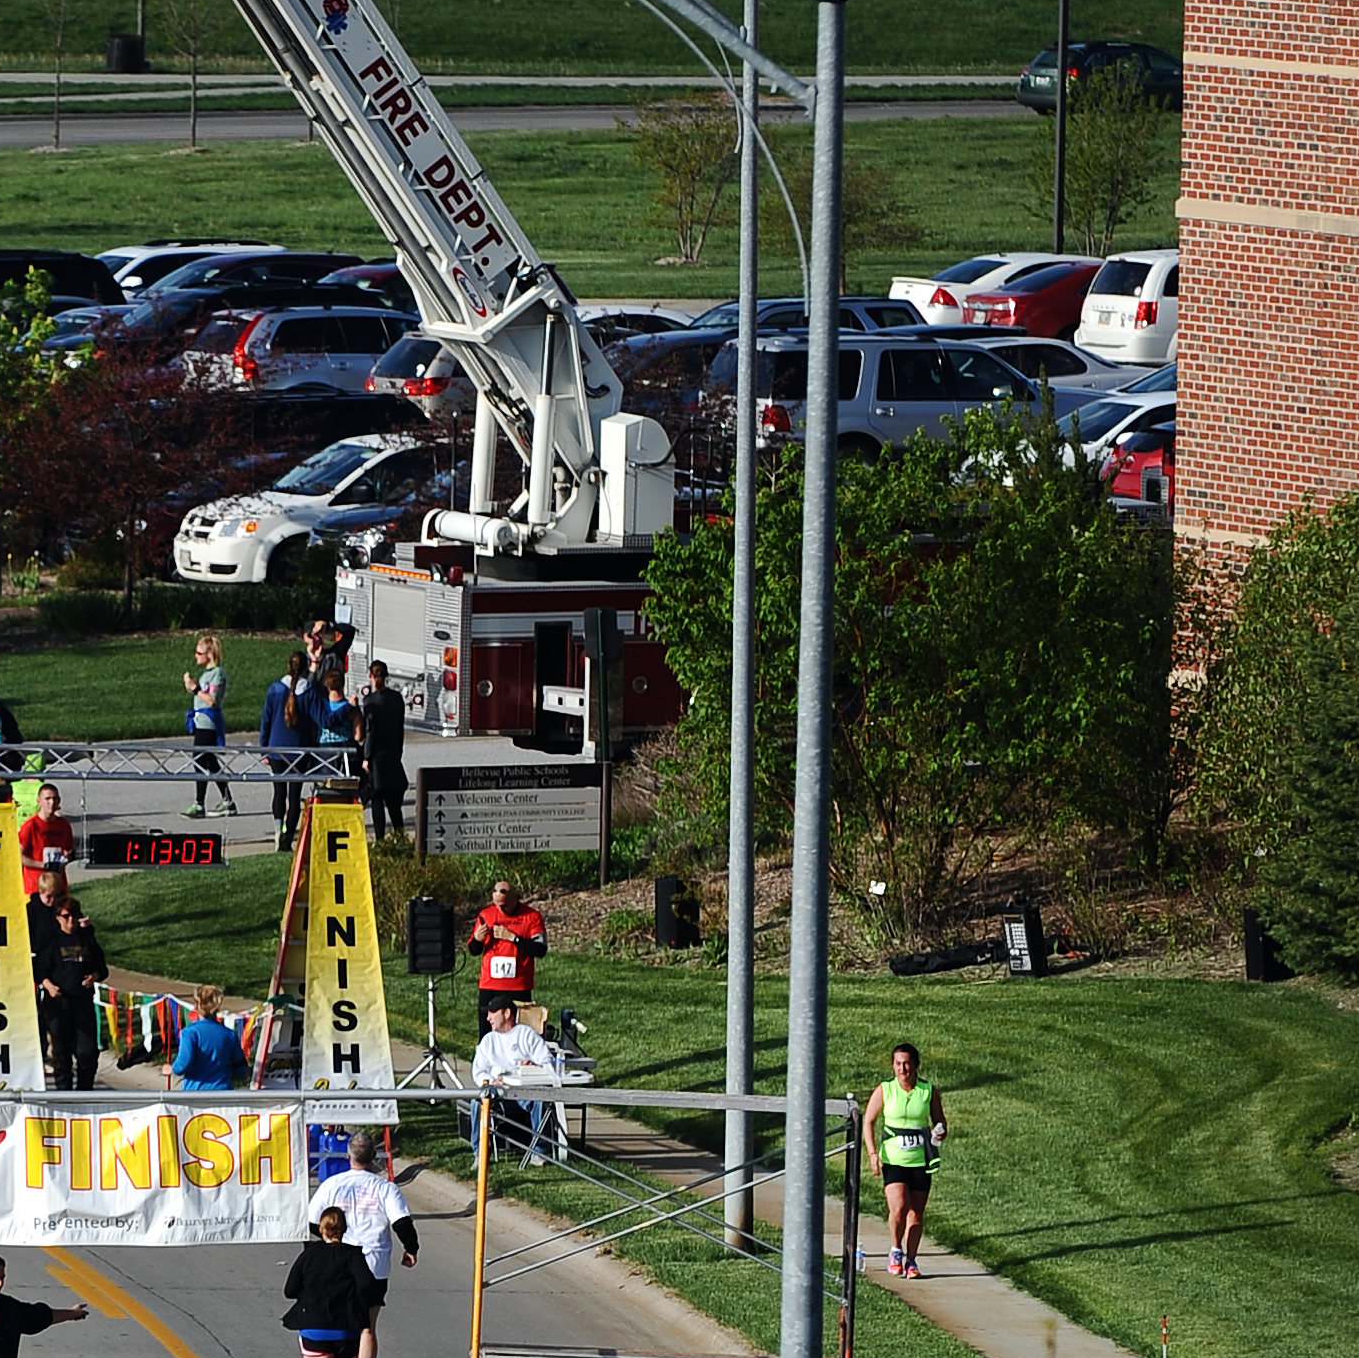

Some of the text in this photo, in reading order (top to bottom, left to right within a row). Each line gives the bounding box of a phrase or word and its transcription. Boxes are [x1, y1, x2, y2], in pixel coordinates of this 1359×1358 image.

[358, 55, 504, 267] FIRE DEPT.
[461, 765, 570, 778] Bellevue Public Schools
[458, 776, 572, 789] Lifelong Learning Center
[454, 792, 540, 805] Welcome Center
[470, 808, 585, 819] METROPOLITAN COMMUNITY COLLEGE
[454, 822, 532, 836] Activity Center
[454, 838, 552, 852] Softball Parking Lot
[326, 830, 361, 1074] FINISH
[495, 962, 513, 975] 147
[24, 1113, 292, 1192] FINISH
[115, 1217, 139, 1233] by:
[252, 1214, 281, 1224] CENTER
